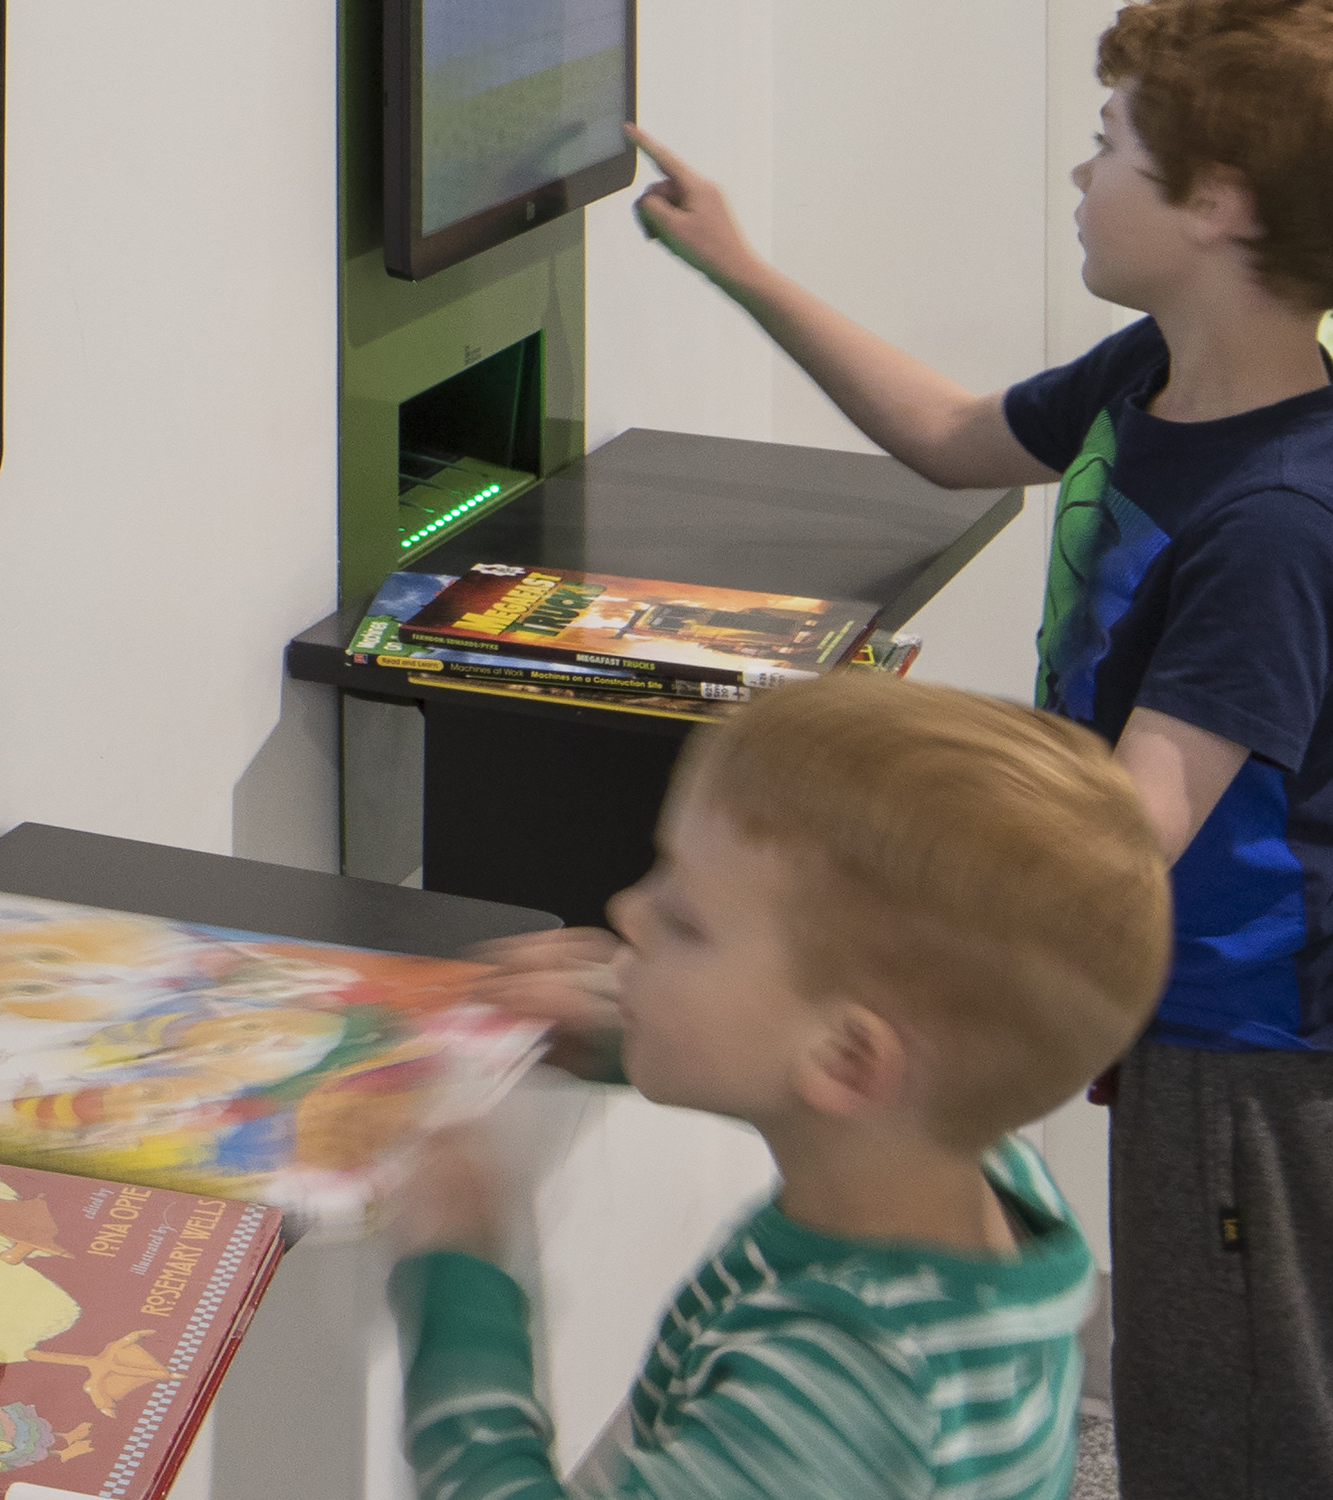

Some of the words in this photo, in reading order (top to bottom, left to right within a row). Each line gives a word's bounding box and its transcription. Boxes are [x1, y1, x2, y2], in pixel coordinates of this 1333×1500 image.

[451, 572, 563, 636] MEGAFAST
[505, 581, 607, 637] TRUCKS
[382, 657, 400, 666] Read
[450, 663, 491, 675] Machines
[493, 667, 502, 676] at
[504, 668, 524, 677] Work
[576, 653, 621, 667] MEGAFAST
[622, 659, 656, 671] TRUCKS
[531, 671, 570, 681] Machines
[593, 676, 646, 688] Construction
[648, 681, 663, 689] Site
[109, 1186, 152, 1221] OPIE
[86, 1222, 133, 1258] IONA
[130, 1233, 164, 1276] illustrated
[140, 1240, 204, 1318] ROSEMARY
[179, 1198, 227, 1241] WELLS
